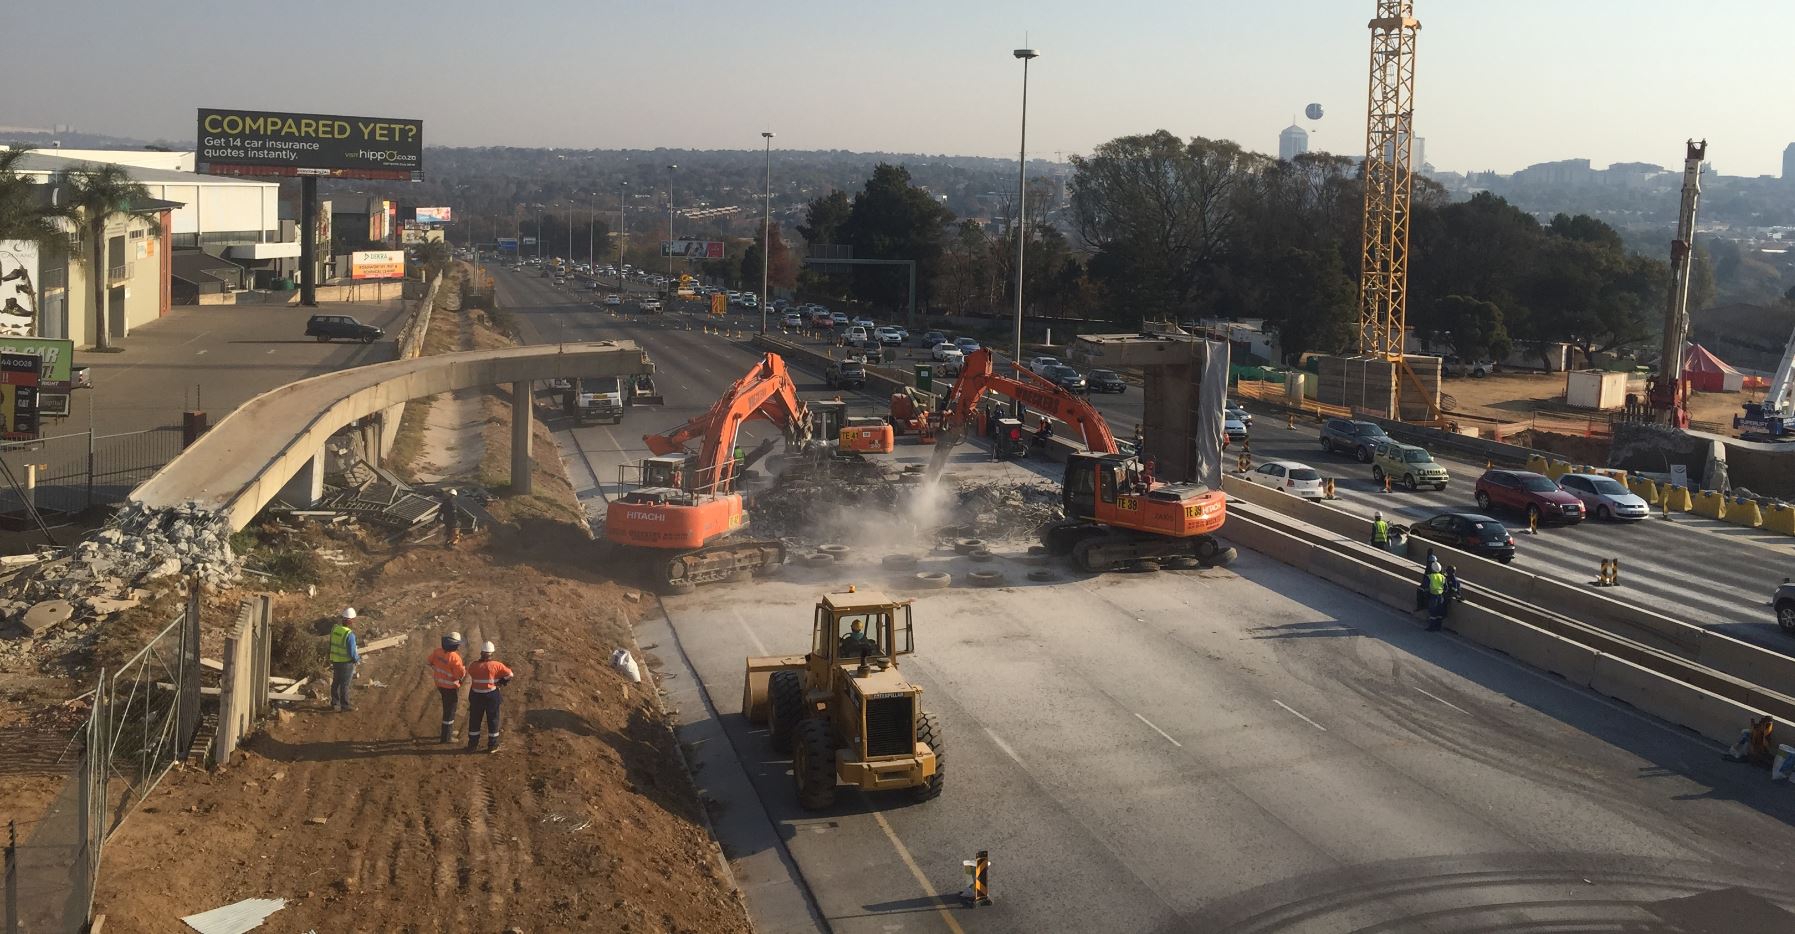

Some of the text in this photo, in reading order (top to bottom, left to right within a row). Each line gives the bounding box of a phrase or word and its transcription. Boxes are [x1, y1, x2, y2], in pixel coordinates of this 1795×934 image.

[204, 114, 417, 142] COMPARED YET?
[204, 136, 320, 150] Get 14 car insurance
[203, 148, 299, 161] quotes instantly.
[626, 511, 666, 522] HITACHI
[1185, 507, 1193, 518] TE
